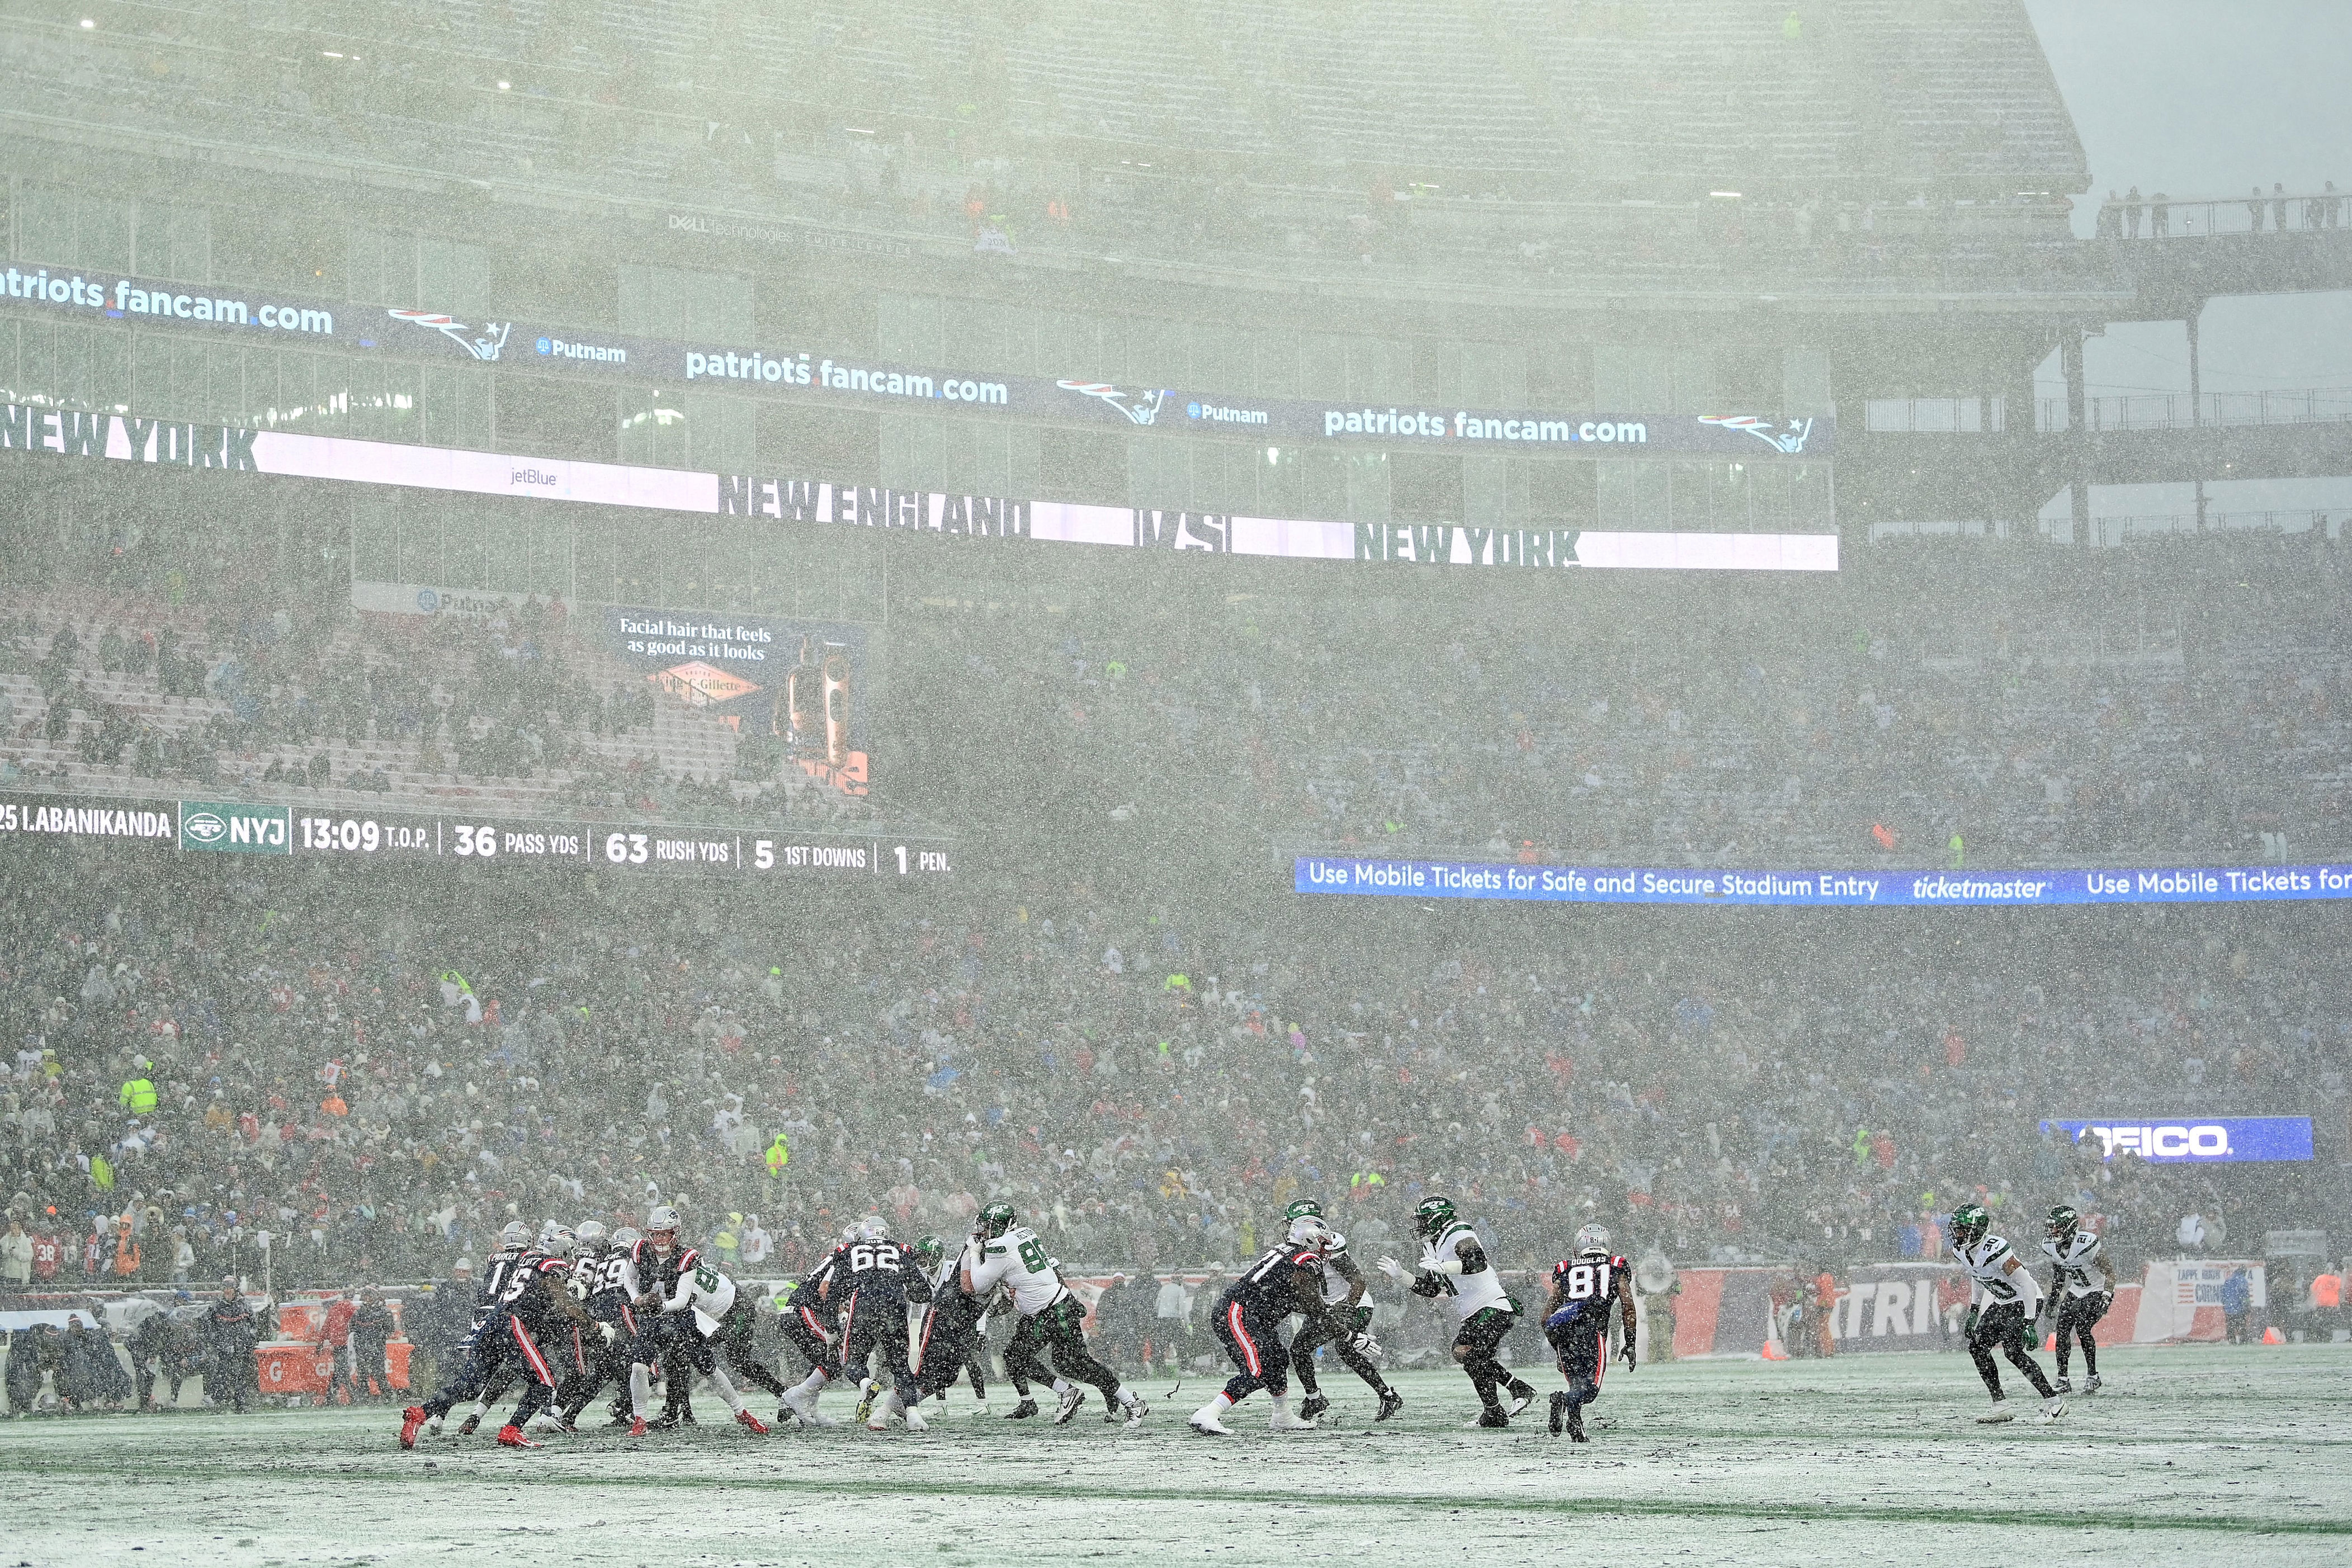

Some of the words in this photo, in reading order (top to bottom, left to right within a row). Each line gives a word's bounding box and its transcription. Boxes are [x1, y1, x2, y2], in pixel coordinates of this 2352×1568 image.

[669, 214, 709, 232] DELL
[709, 218, 793, 244] Technologies
[0, 268, 332, 334] triots.fancam.com
[552, 339, 626, 363] Putnam
[687, 350, 1007, 404] patriots.fancam.com
[1202, 404, 1268, 424] Putnam
[1325, 408, 1646, 443] patriots.fancam.com
[0, 404, 111, 457] NEW
[111, 415, 258, 473] YORK
[511, 469, 556, 487] jetBlue
[719, 474, 820, 522] NEW
[832, 484, 1031, 538] ENGLAND
[1144, 509, 1225, 552] VS
[1354, 523, 1453, 563] NEW
[1454, 528, 1582, 568] YORK
[441, 593, 503, 613] Putna
[620, 618, 664, 635] Facial
[667, 621, 698, 637] hair
[701, 624, 733, 640] that
[736, 626, 772, 643] feels
[627, 640, 644, 653] as
[647, 640, 686, 656] good
[688, 645, 706, 657] as
[709, 643, 720, 658] it
[723, 643, 765, 660] looks
[23, 806, 171, 838] I.ABANIKANDA
[230, 816, 285, 845] NYJ
[300, 818, 380, 851] 13:09
[385, 826, 429, 849] T.O.P.
[454, 825, 497, 857] 36
[505, 832, 545, 854] PASS
[549, 834, 579, 855] YDS
[606, 833, 648, 864] 63
[656, 839, 695, 861] RUSH
[699, 842, 729, 862] YDS
[754, 840, 774, 869] 5
[784, 846, 810, 866] 1ST
[813, 847, 866, 868] DOWNS
[894, 846, 907, 875] 1
[920, 851, 951, 872] PEN.
[1310, 862, 1348, 884] Use
[1355, 864, 1425, 887] Mobile
[1432, 866, 1501, 889] Tickets
[1507, 868, 1536, 890] for
[1542, 870, 1587, 892] Safe
[1594, 871, 1635, 893] and
[1643, 873, 1715, 894] Secure
[1722, 874, 1812, 895] Stadium
[1820, 875, 1879, 899] Entry
[1912, 876, 2046, 898] ticketmaster
[2087, 873, 2130, 894] Use
[2138, 871, 2218, 893] Mobile
[2225, 870, 2311, 892] Tickets
[2318, 868, 2352, 889] for
[37, 1244, 55, 1262] 38
[1983, 1238, 1999, 1252] 30
[2077, 1235, 2088, 1244] 21
[491, 1252, 519, 1261] PARKER
[851, 1244, 900, 1273] 62
[1571, 1256, 1607, 1265] DOUGLAS
[488, 1262, 506, 1294] 1
[1568, 1263, 1611, 1300] 81
[270, 1361, 281, 1381] G
